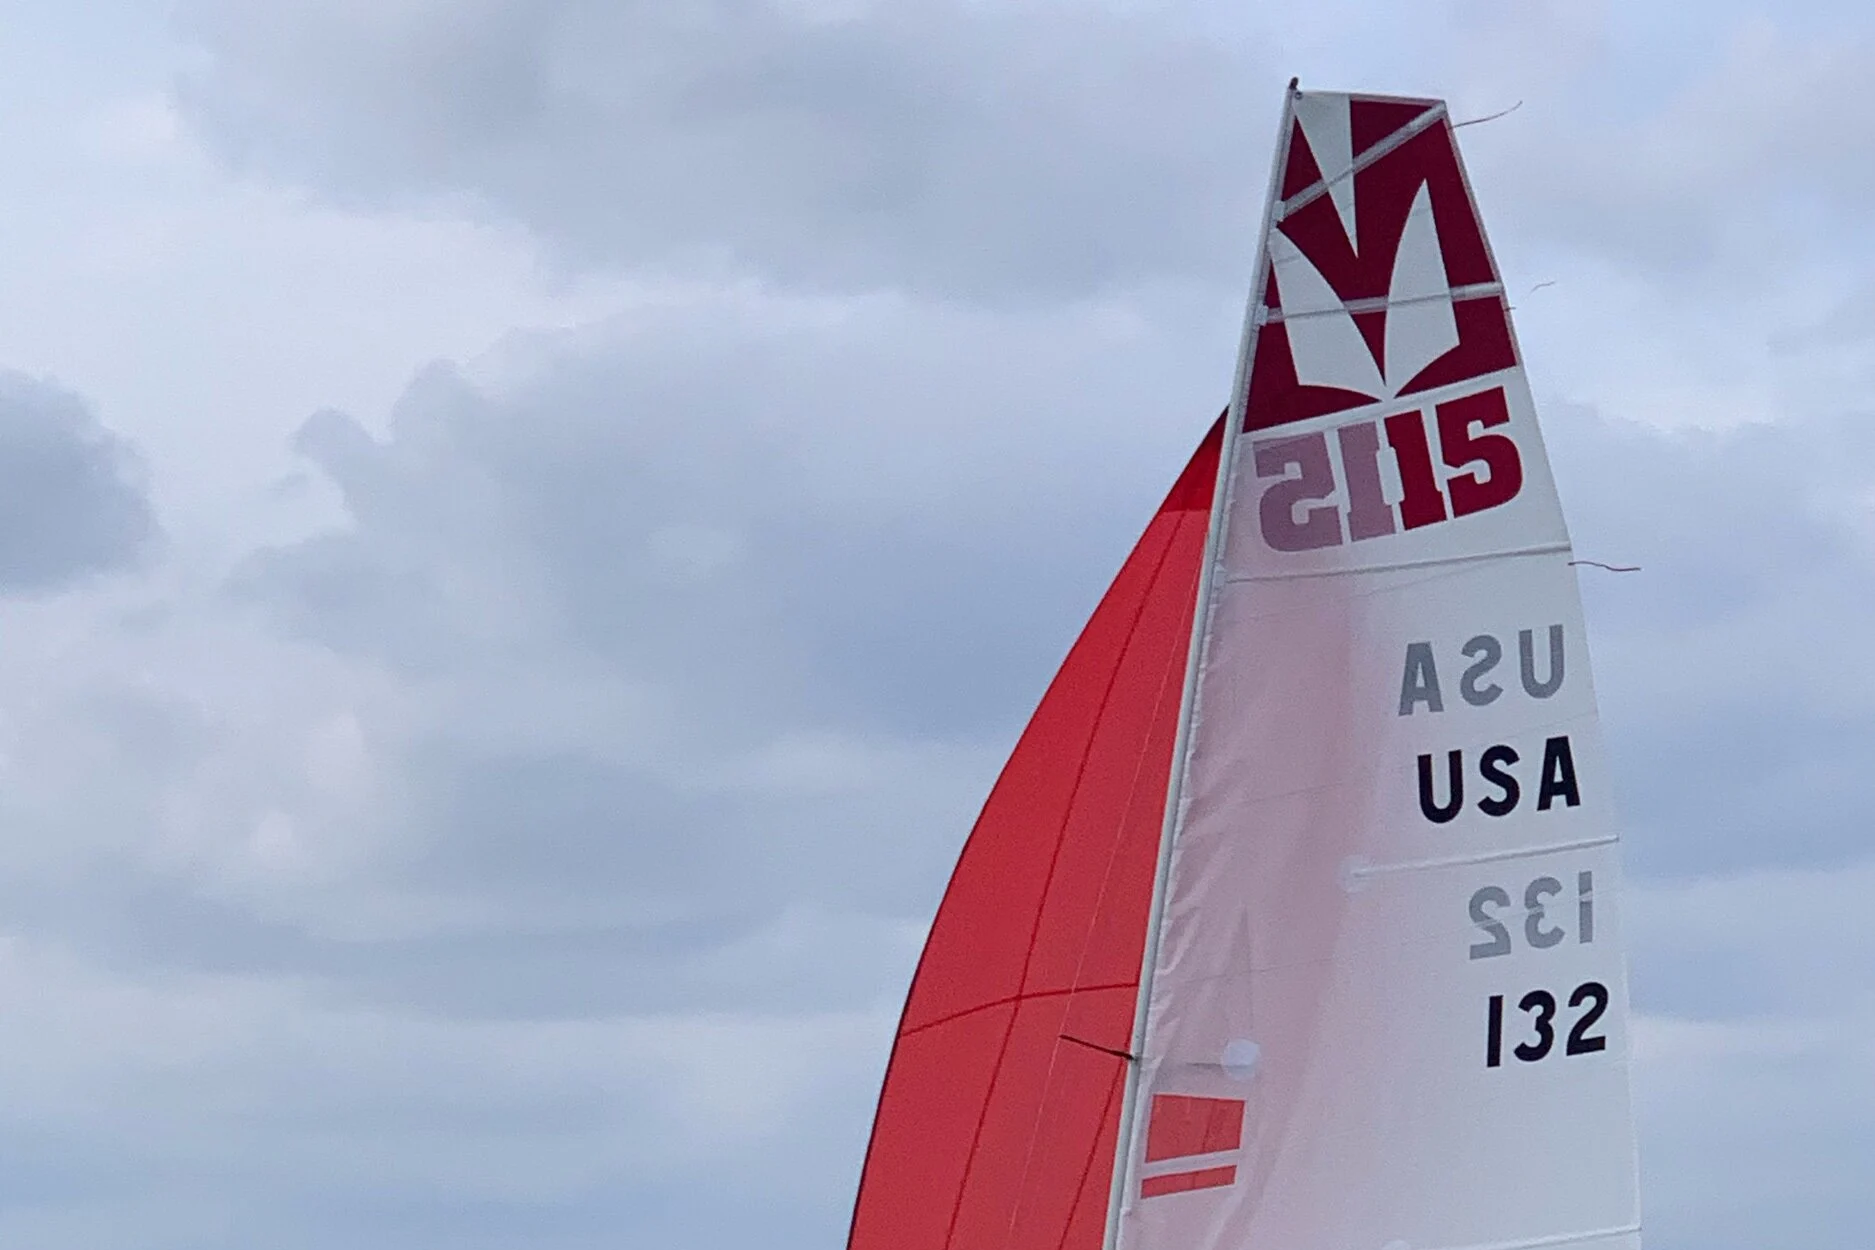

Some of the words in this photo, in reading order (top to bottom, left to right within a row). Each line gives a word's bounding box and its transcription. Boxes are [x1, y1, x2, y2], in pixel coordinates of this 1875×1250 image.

[1383, 385, 1524, 531] 15
[1417, 735, 1582, 824] USA
[1486, 982, 1609, 1068] 132
